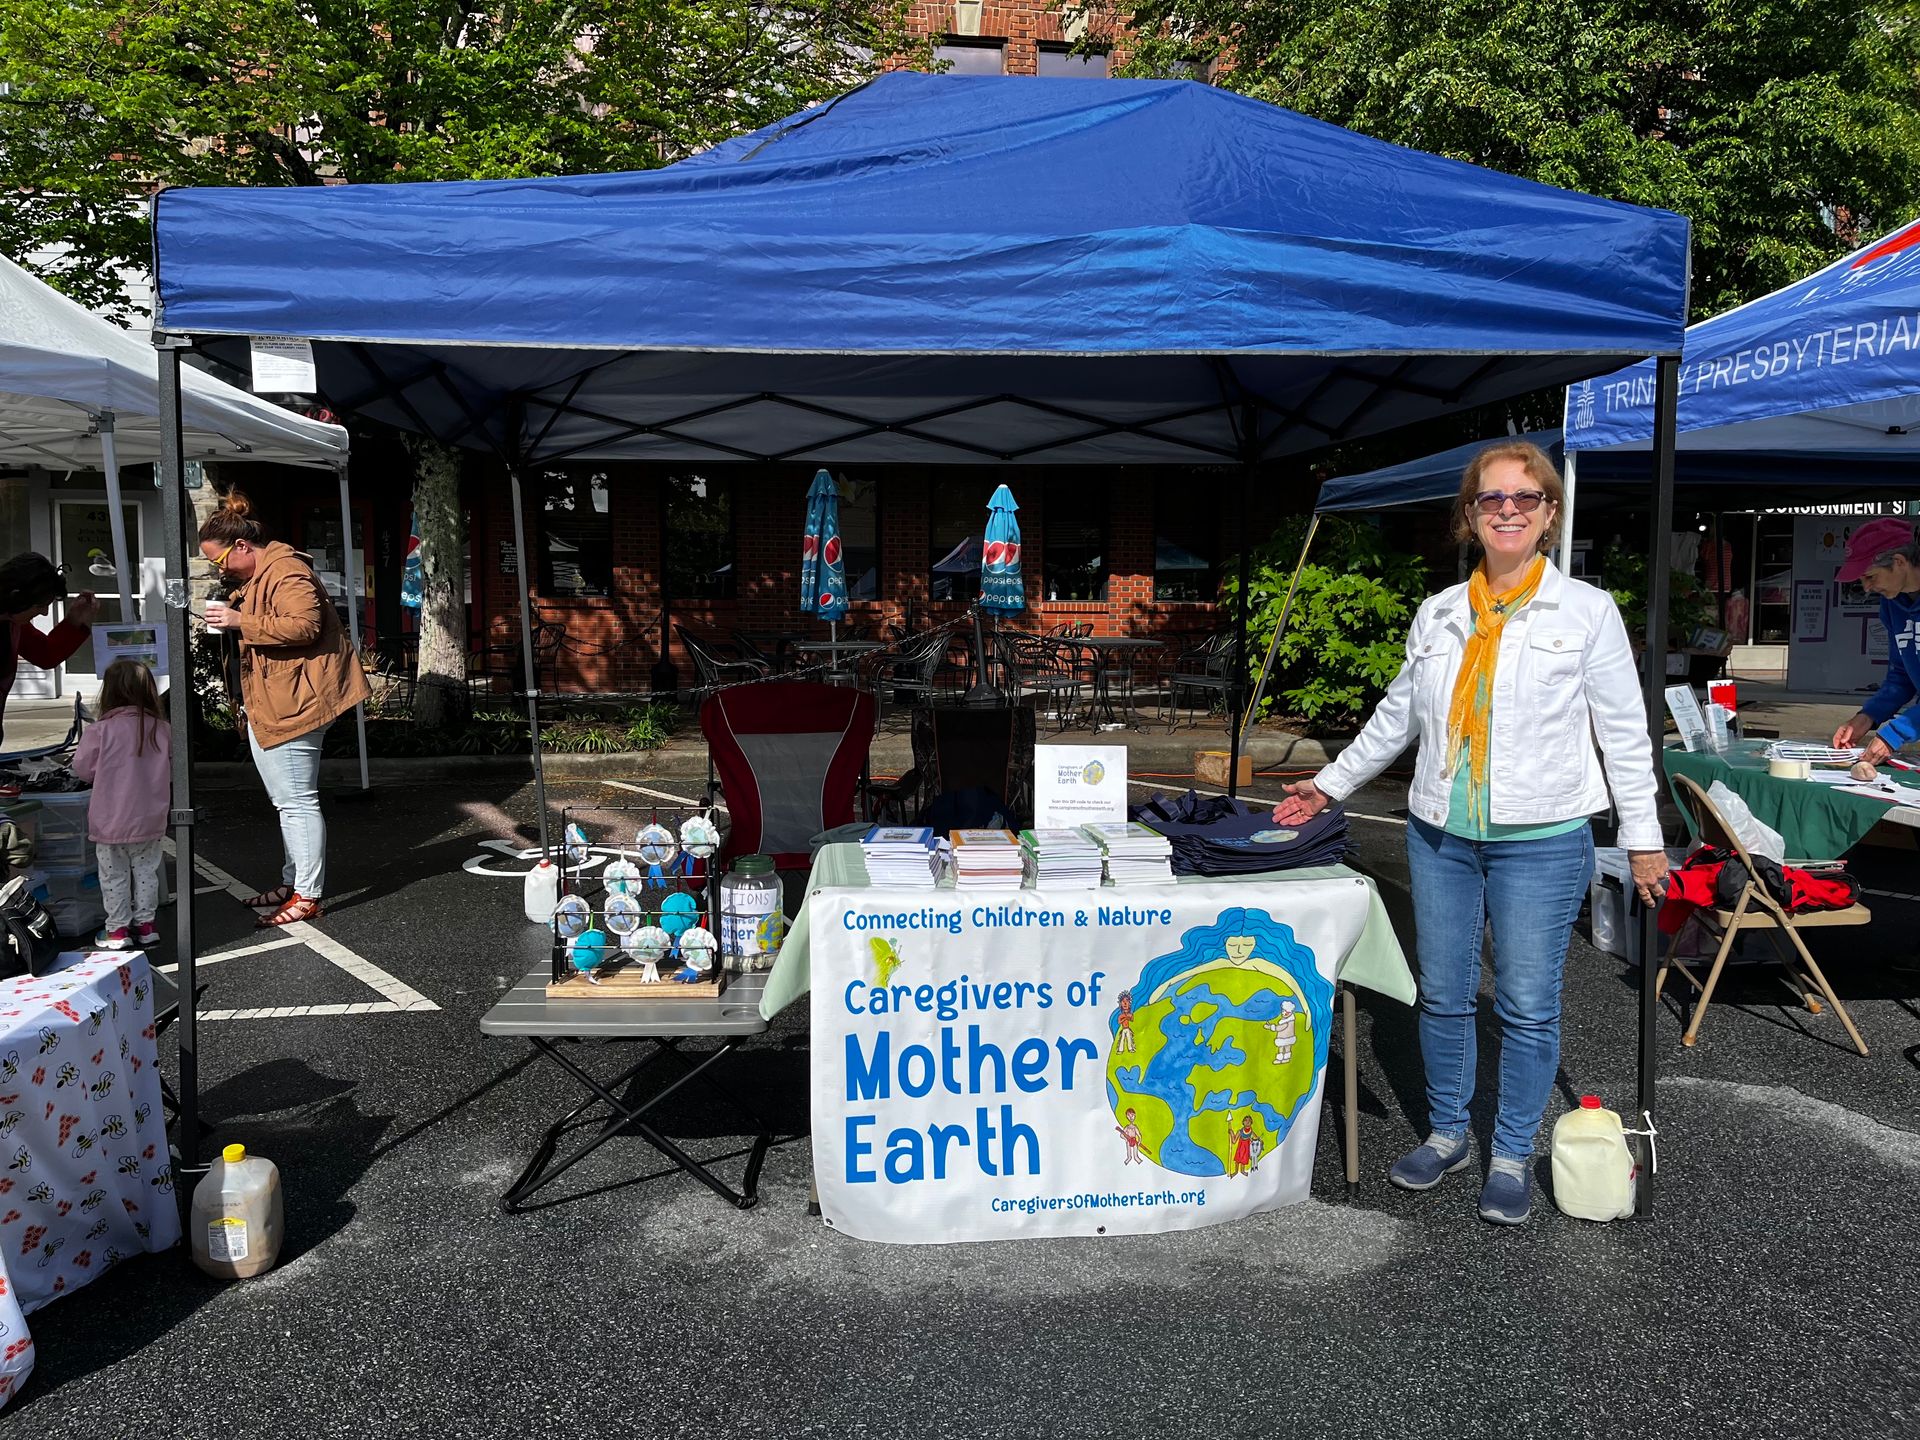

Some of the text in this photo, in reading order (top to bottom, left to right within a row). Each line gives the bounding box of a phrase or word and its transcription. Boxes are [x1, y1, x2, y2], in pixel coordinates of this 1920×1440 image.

[1603, 312, 1920, 412] TRINIY PRESBYTERIA
[87, 511, 107, 523] 43
[721, 893, 770, 905] NATIONS
[723, 926, 755, 940] other
[843, 907, 1172, 934] Connecting Children & Nature
[722, 941, 743, 955] arth
[845, 972, 1105, 1021] Caregivers of
[845, 1024, 1098, 1101] Mother
[845, 1104, 1040, 1184] Earth
[992, 1190, 1205, 1213] CaregiversOfMotherEarth.org
